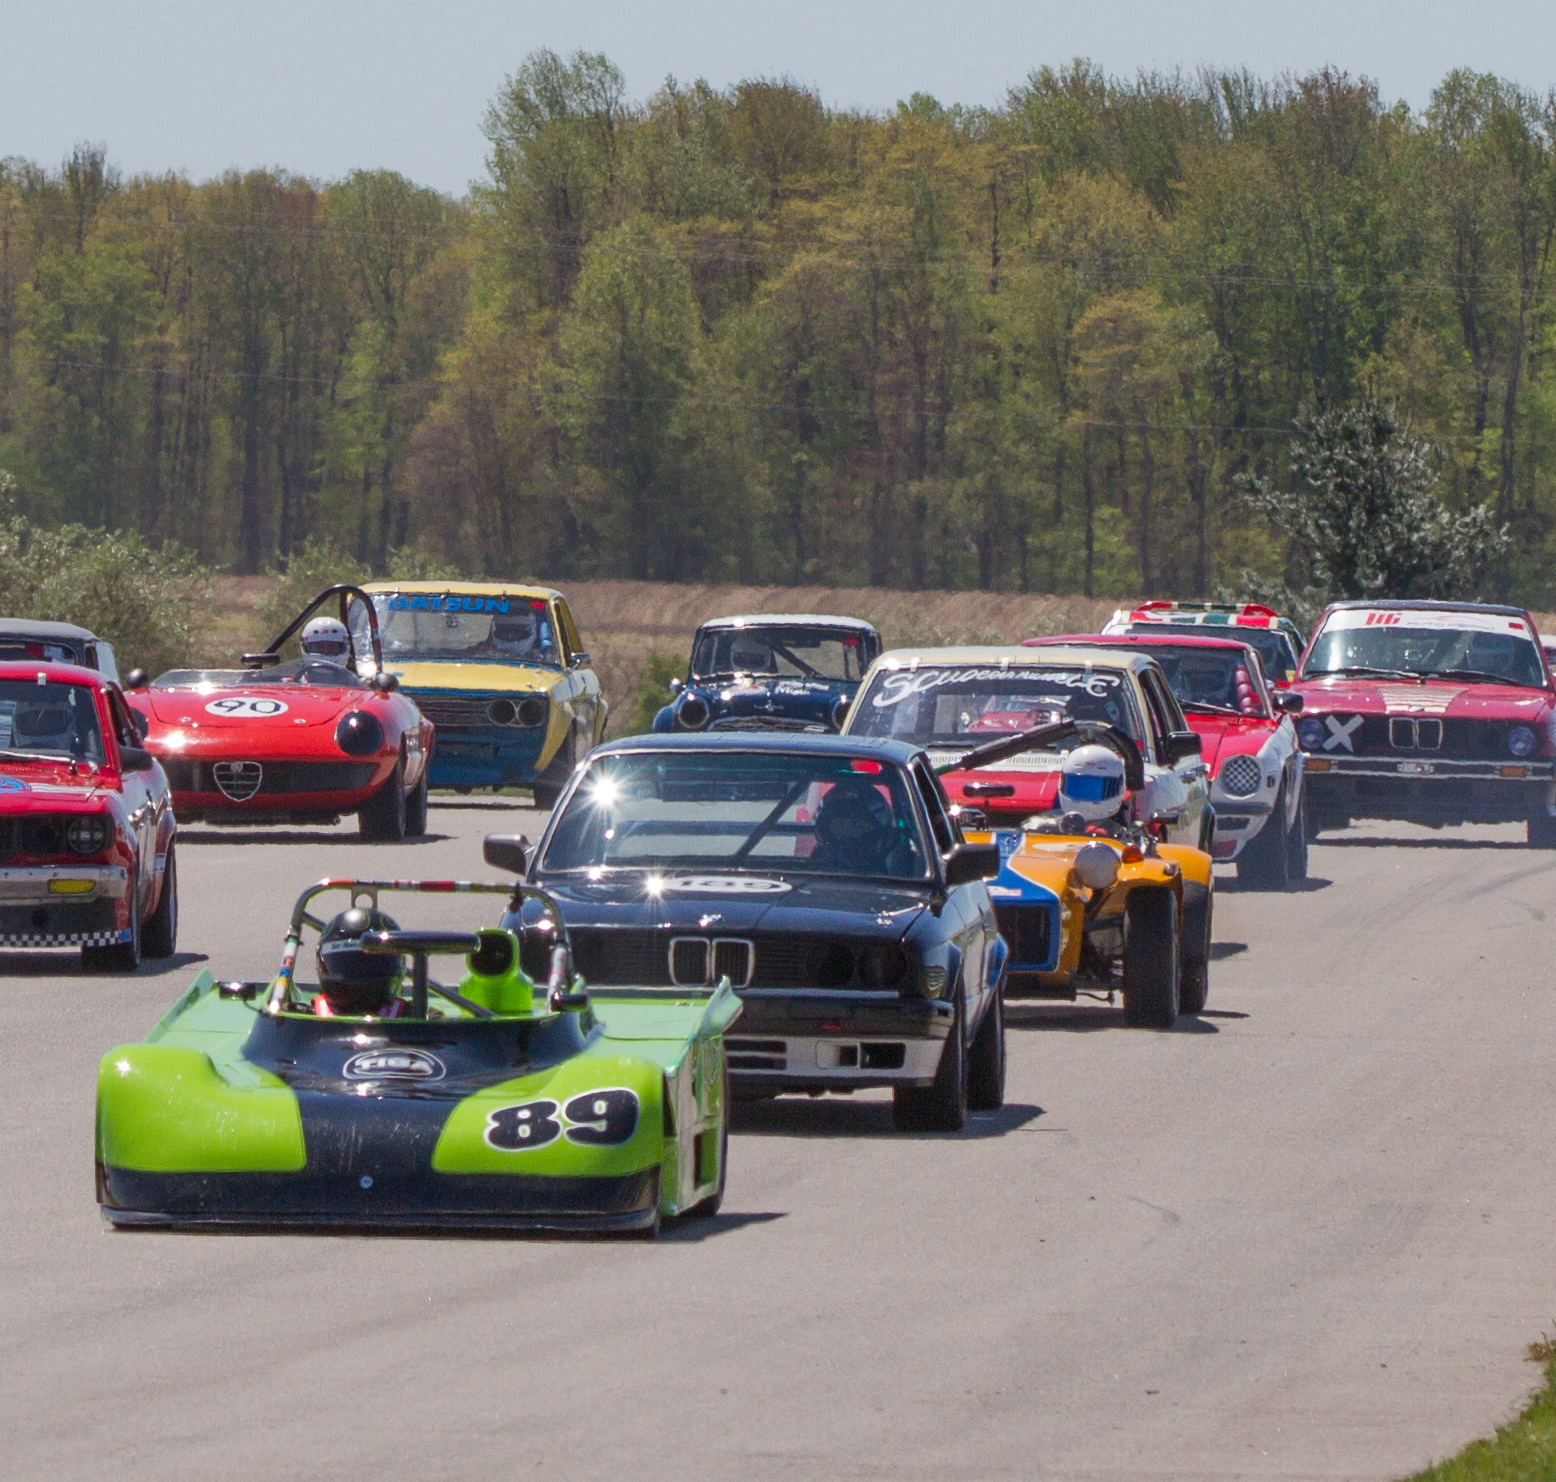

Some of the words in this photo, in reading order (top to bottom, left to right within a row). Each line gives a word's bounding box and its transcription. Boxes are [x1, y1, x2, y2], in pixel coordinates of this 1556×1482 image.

[388, 596, 510, 615] DATSUN
[213, 699, 283, 715] 90
[483, 1086, 641, 1153] 89
